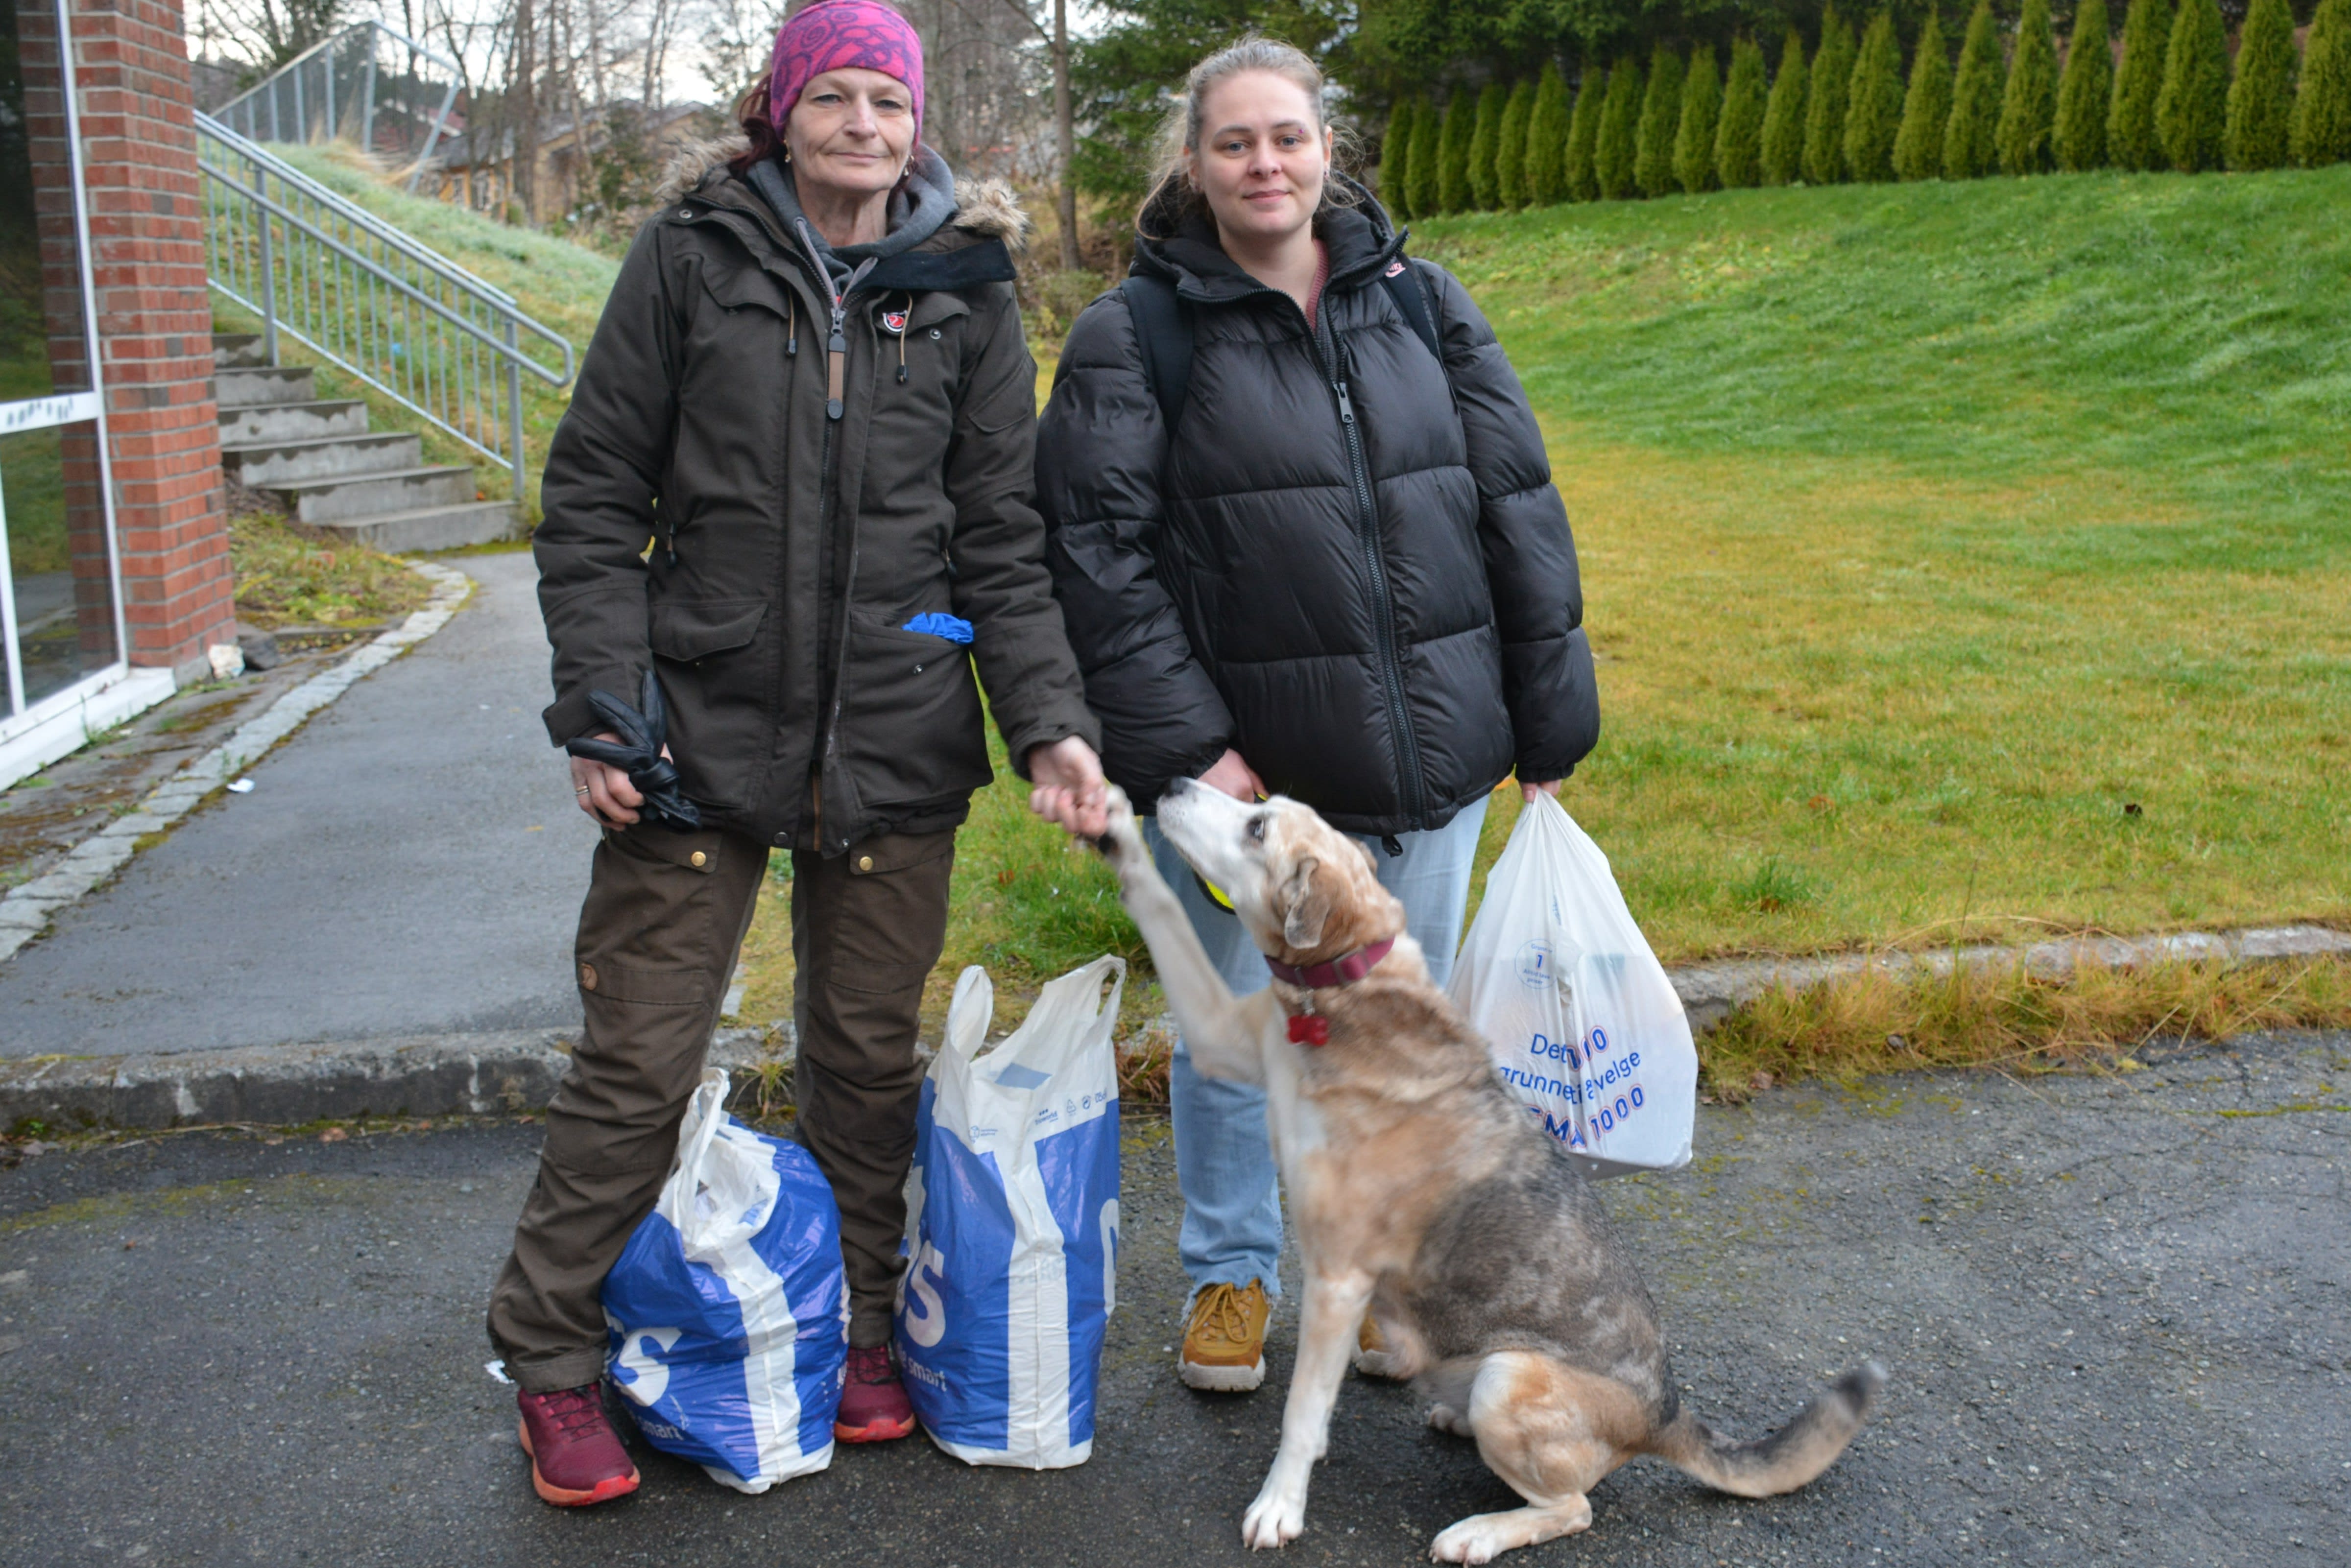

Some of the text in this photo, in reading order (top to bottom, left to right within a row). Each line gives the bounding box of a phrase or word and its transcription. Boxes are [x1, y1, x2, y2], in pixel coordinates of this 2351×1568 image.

[1537, 954, 1543, 968] 1
[1530, 1034, 1567, 1064] Det
[1594, 1052, 1641, 1090] velge
[1591, 1087, 1643, 1138] 1000
